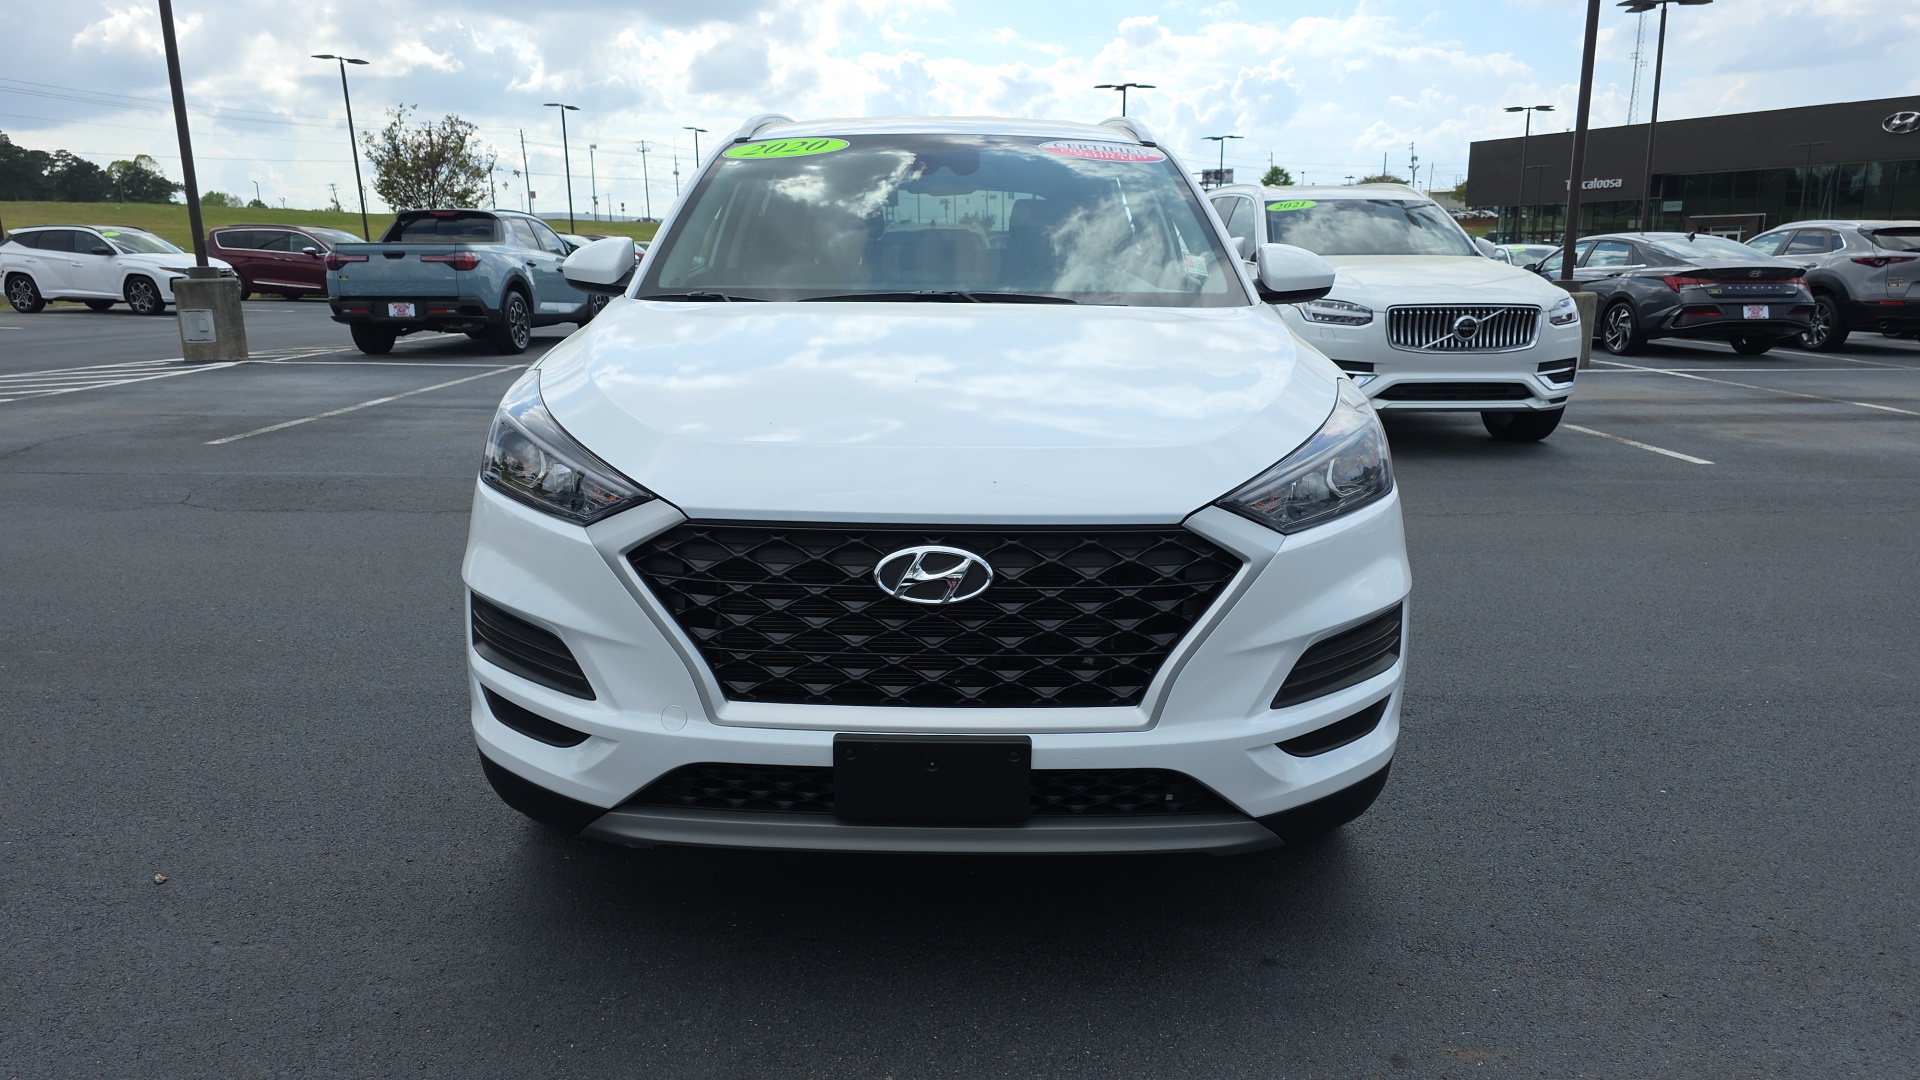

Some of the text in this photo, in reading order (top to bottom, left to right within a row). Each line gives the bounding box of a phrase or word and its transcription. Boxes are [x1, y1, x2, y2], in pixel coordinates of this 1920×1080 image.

[740, 140, 830, 156] 2020
[1053, 142, 1149, 155] CERTIFIED
[1565, 178, 1623, 190] Tcaloosa
[1275, 201, 1306, 210] 2021
